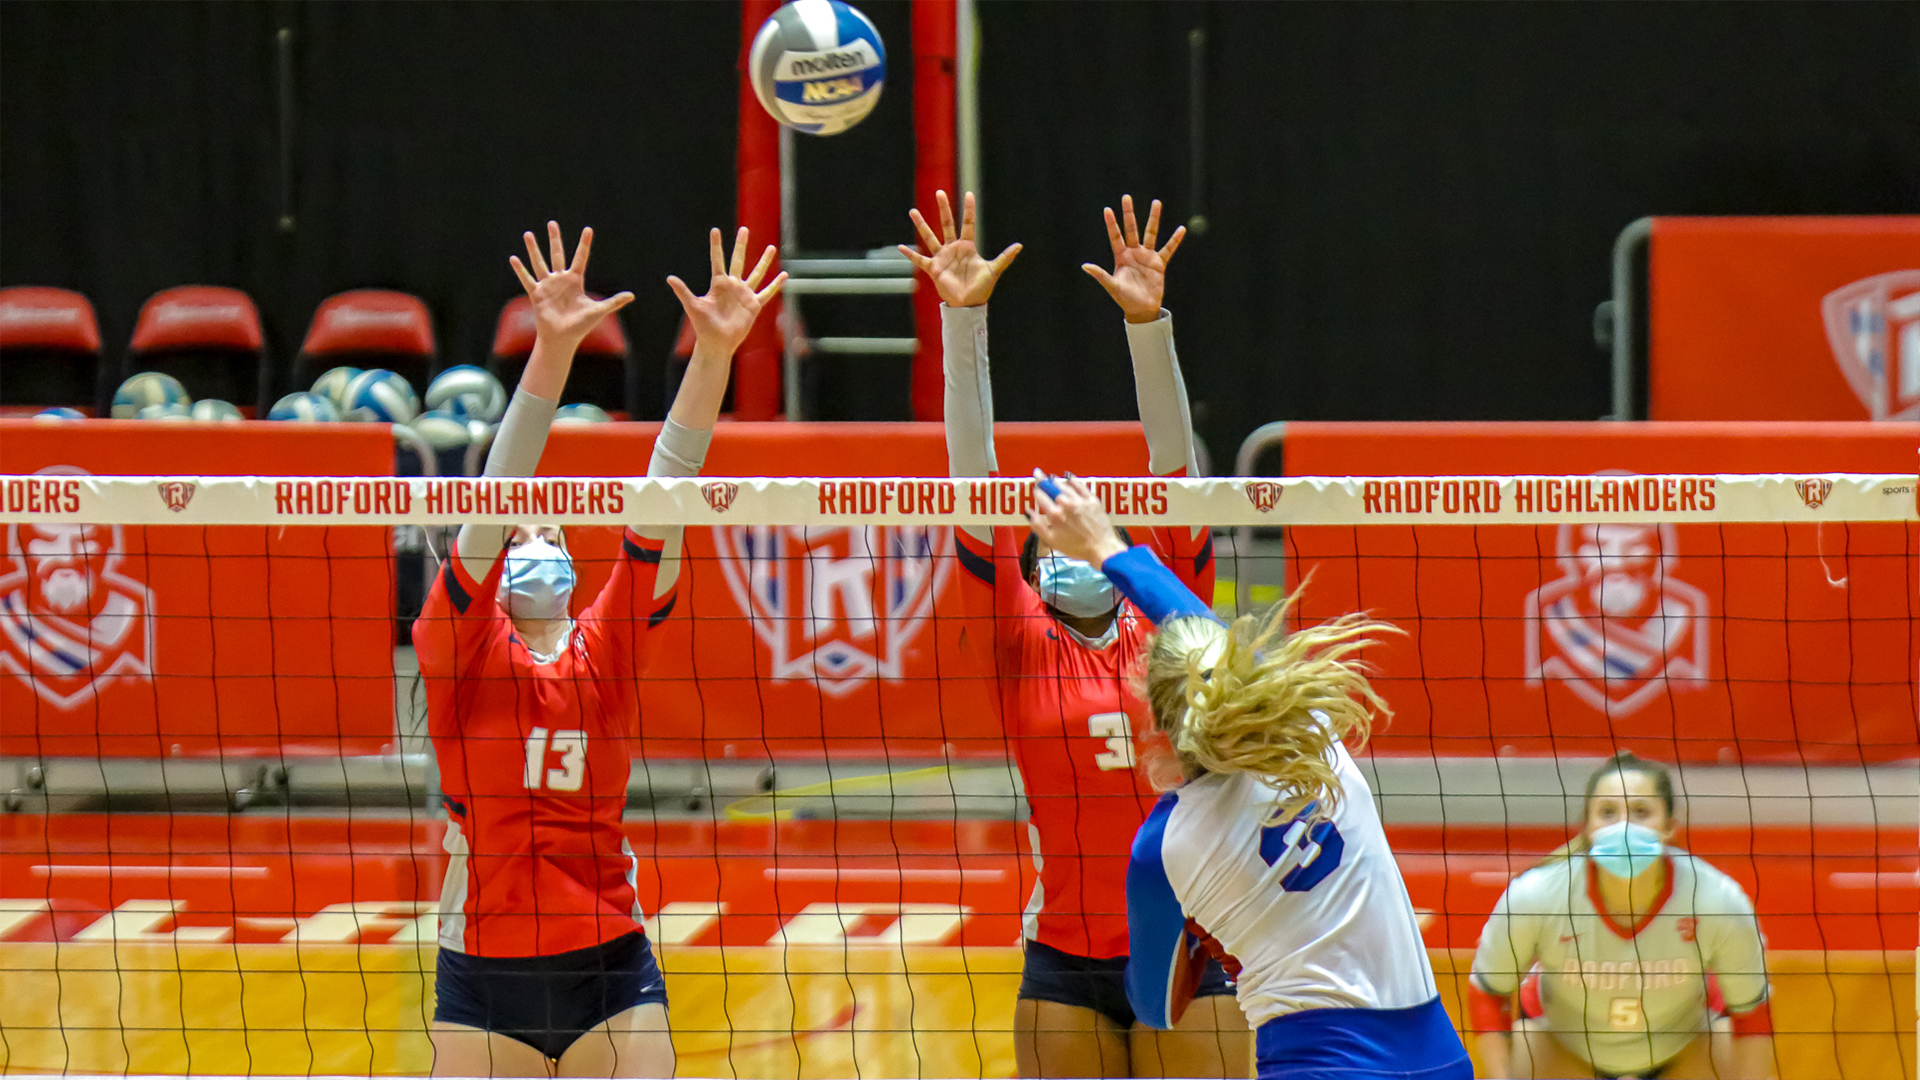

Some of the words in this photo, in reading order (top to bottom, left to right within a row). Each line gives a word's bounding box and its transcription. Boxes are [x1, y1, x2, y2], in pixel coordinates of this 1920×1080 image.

[791, 51, 866, 75] molten
[0, 479, 80, 513] DERS
[274, 480, 412, 515] RADFORD
[424, 480, 624, 515] HIGHLANDERS
[818, 480, 956, 515] RADFORD
[969, 481, 1168, 515] HIGHDERS
[1362, 480, 1501, 514] RADFORD
[1514, 478, 1716, 513] HIGHLANDERS
[1882, 485, 1910, 496] sports
[1087, 711, 1136, 771] 3
[523, 726, 588, 792] 13
[1562, 957, 1690, 991] RADFORD
[1607, 996, 1642, 1030] 5
